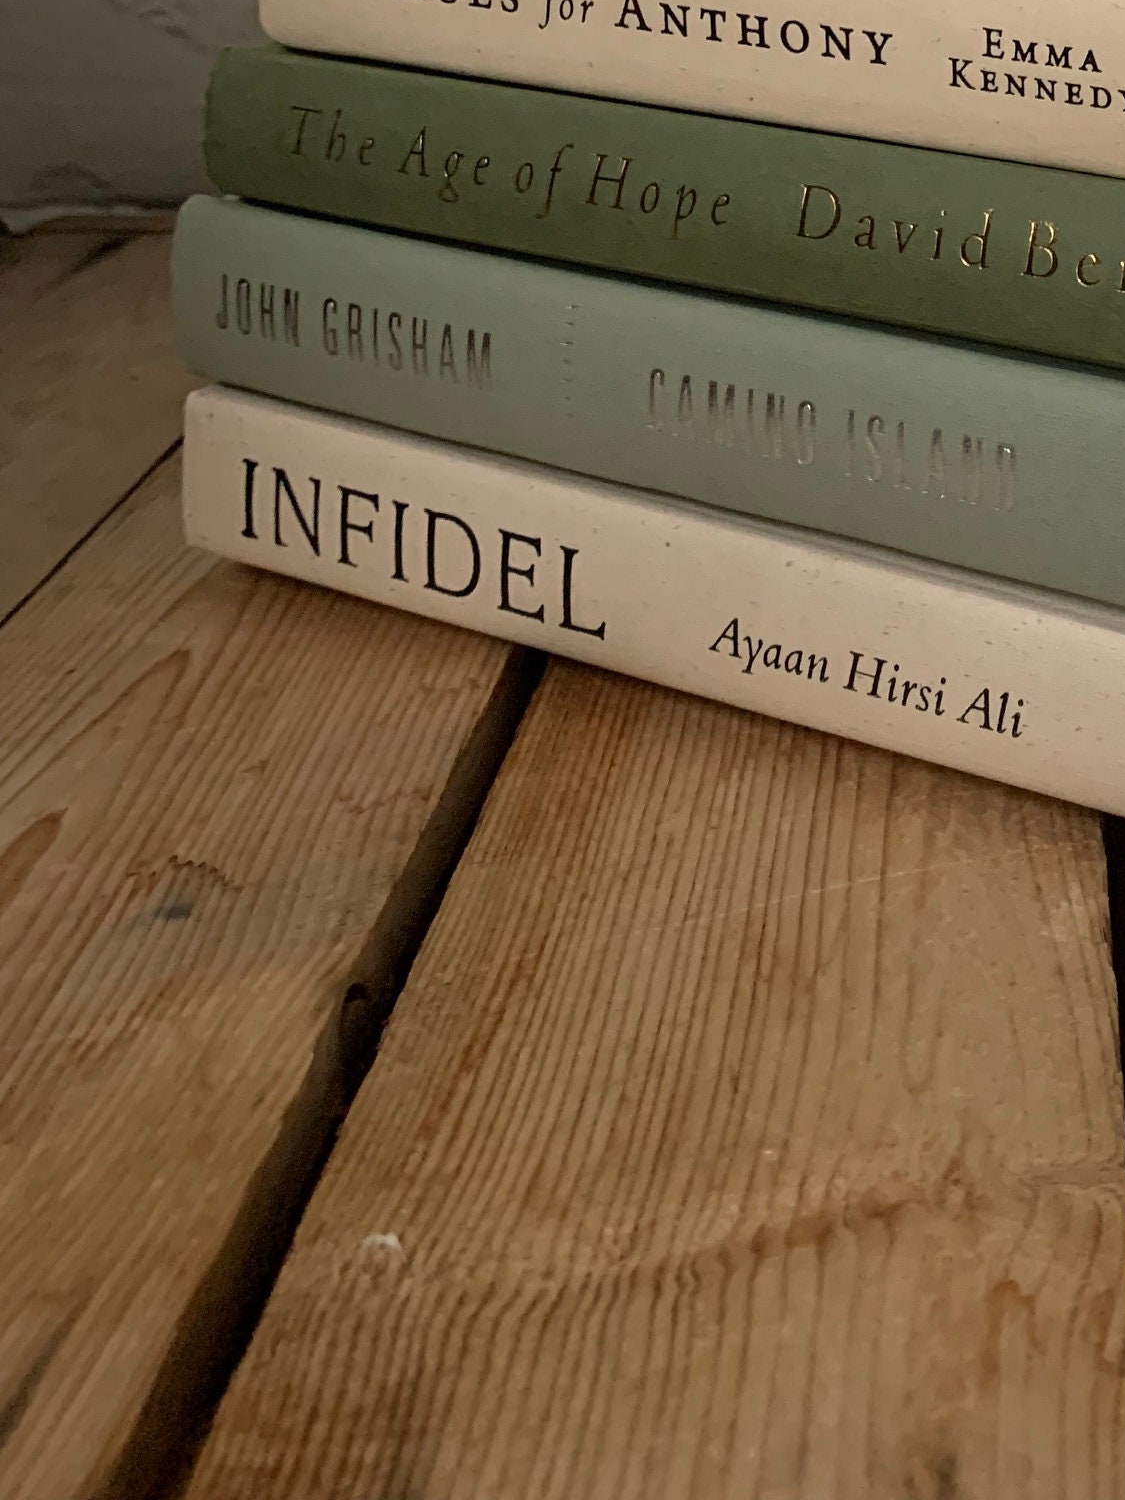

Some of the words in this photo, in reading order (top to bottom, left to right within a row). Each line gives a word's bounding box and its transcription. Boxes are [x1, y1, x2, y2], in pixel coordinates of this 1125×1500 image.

[982, 27, 1103, 74] EMMA
[288, 106, 374, 167] The
[397, 125, 491, 201] Age
[514, 143, 574, 219] of
[584, 153, 730, 239] Hope
[793, 183, 995, 270] David
[215, 273, 300, 348] JOHN
[321, 297, 493, 390] GRISHAM
[646, 367, 817, 467] CAMINO
[844, 408, 1018, 512] ISLAND
[240, 457, 607, 641] INFIDEL
[708, 616, 829, 684] Ayaan
[843, 650, 946, 717] Hirsi
[956, 687, 1025, 739] Ali
